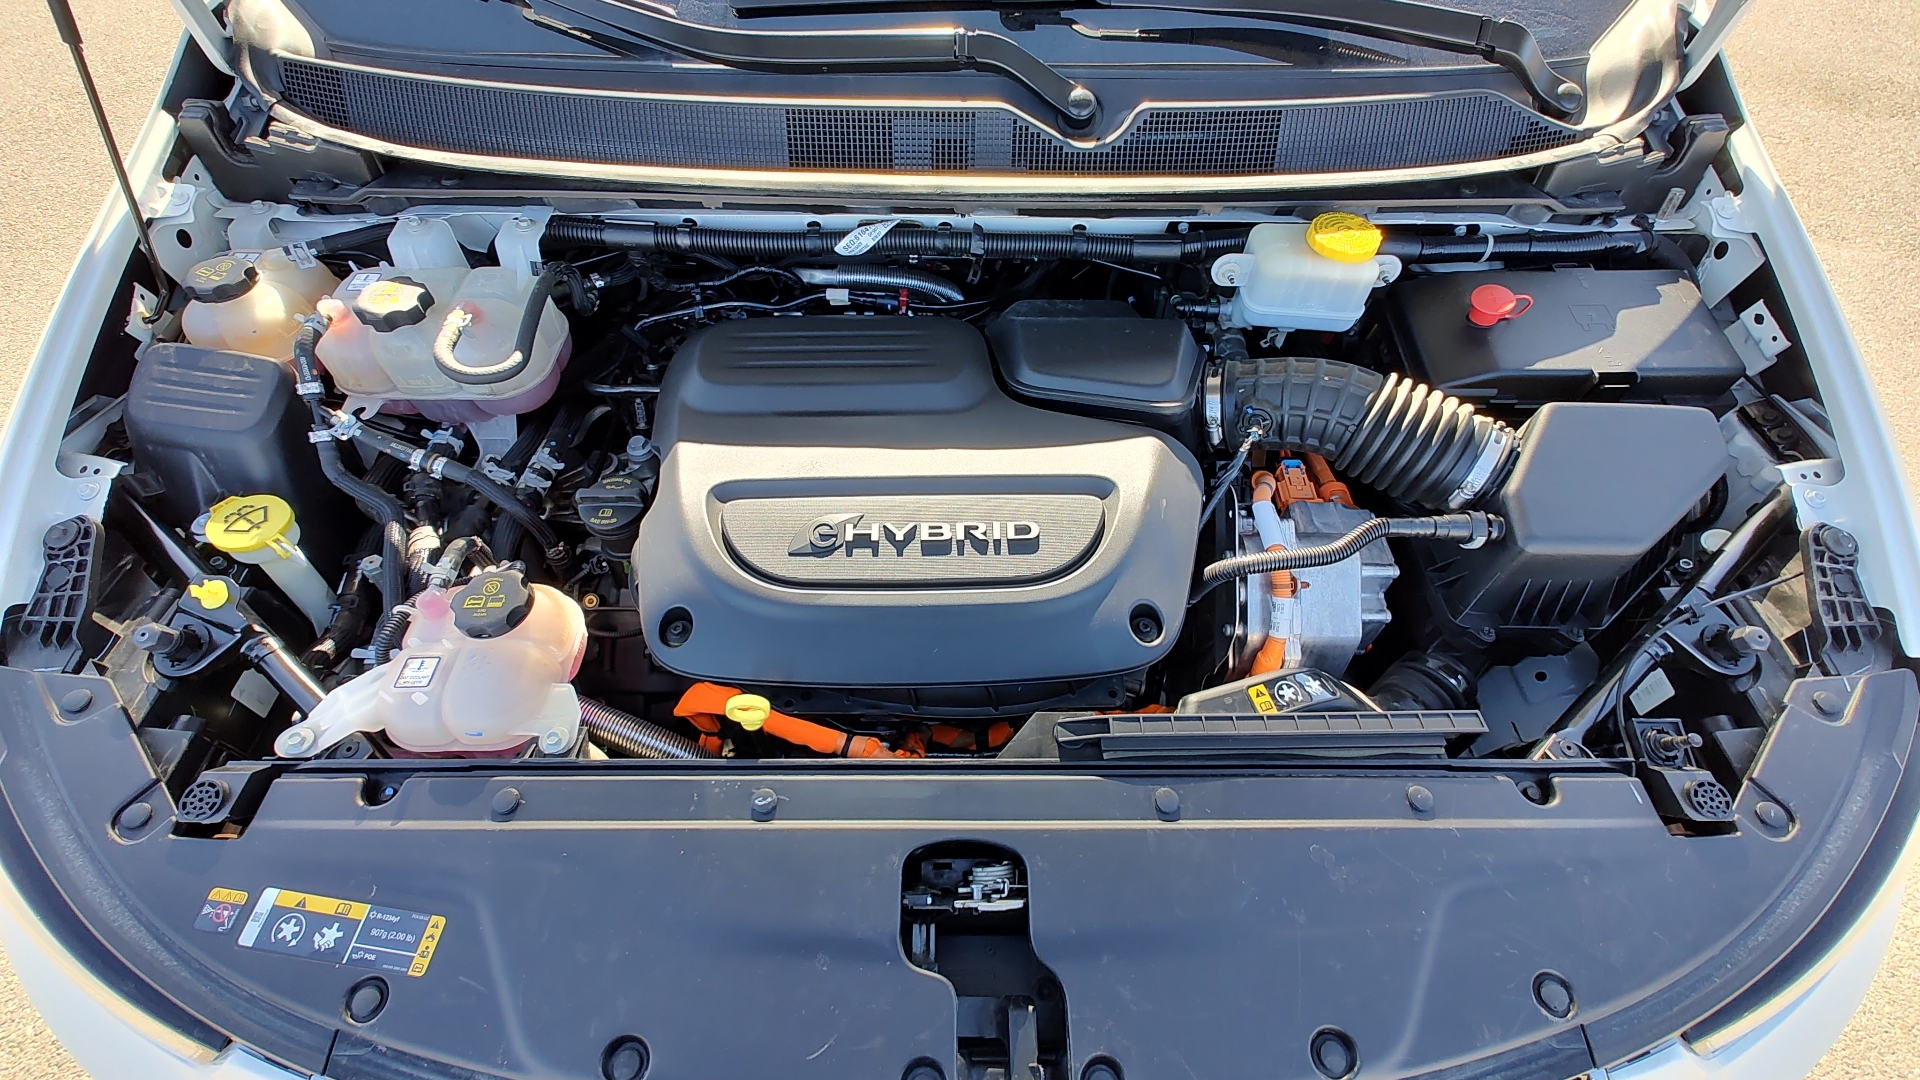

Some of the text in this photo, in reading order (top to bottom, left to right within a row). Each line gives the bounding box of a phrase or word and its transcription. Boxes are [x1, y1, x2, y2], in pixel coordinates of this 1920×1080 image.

[376, 912, 401, 923] R-1234yf
[370, 927, 416, 943] 907g (2.00 lb)
[363, 953, 377, 961] POE
